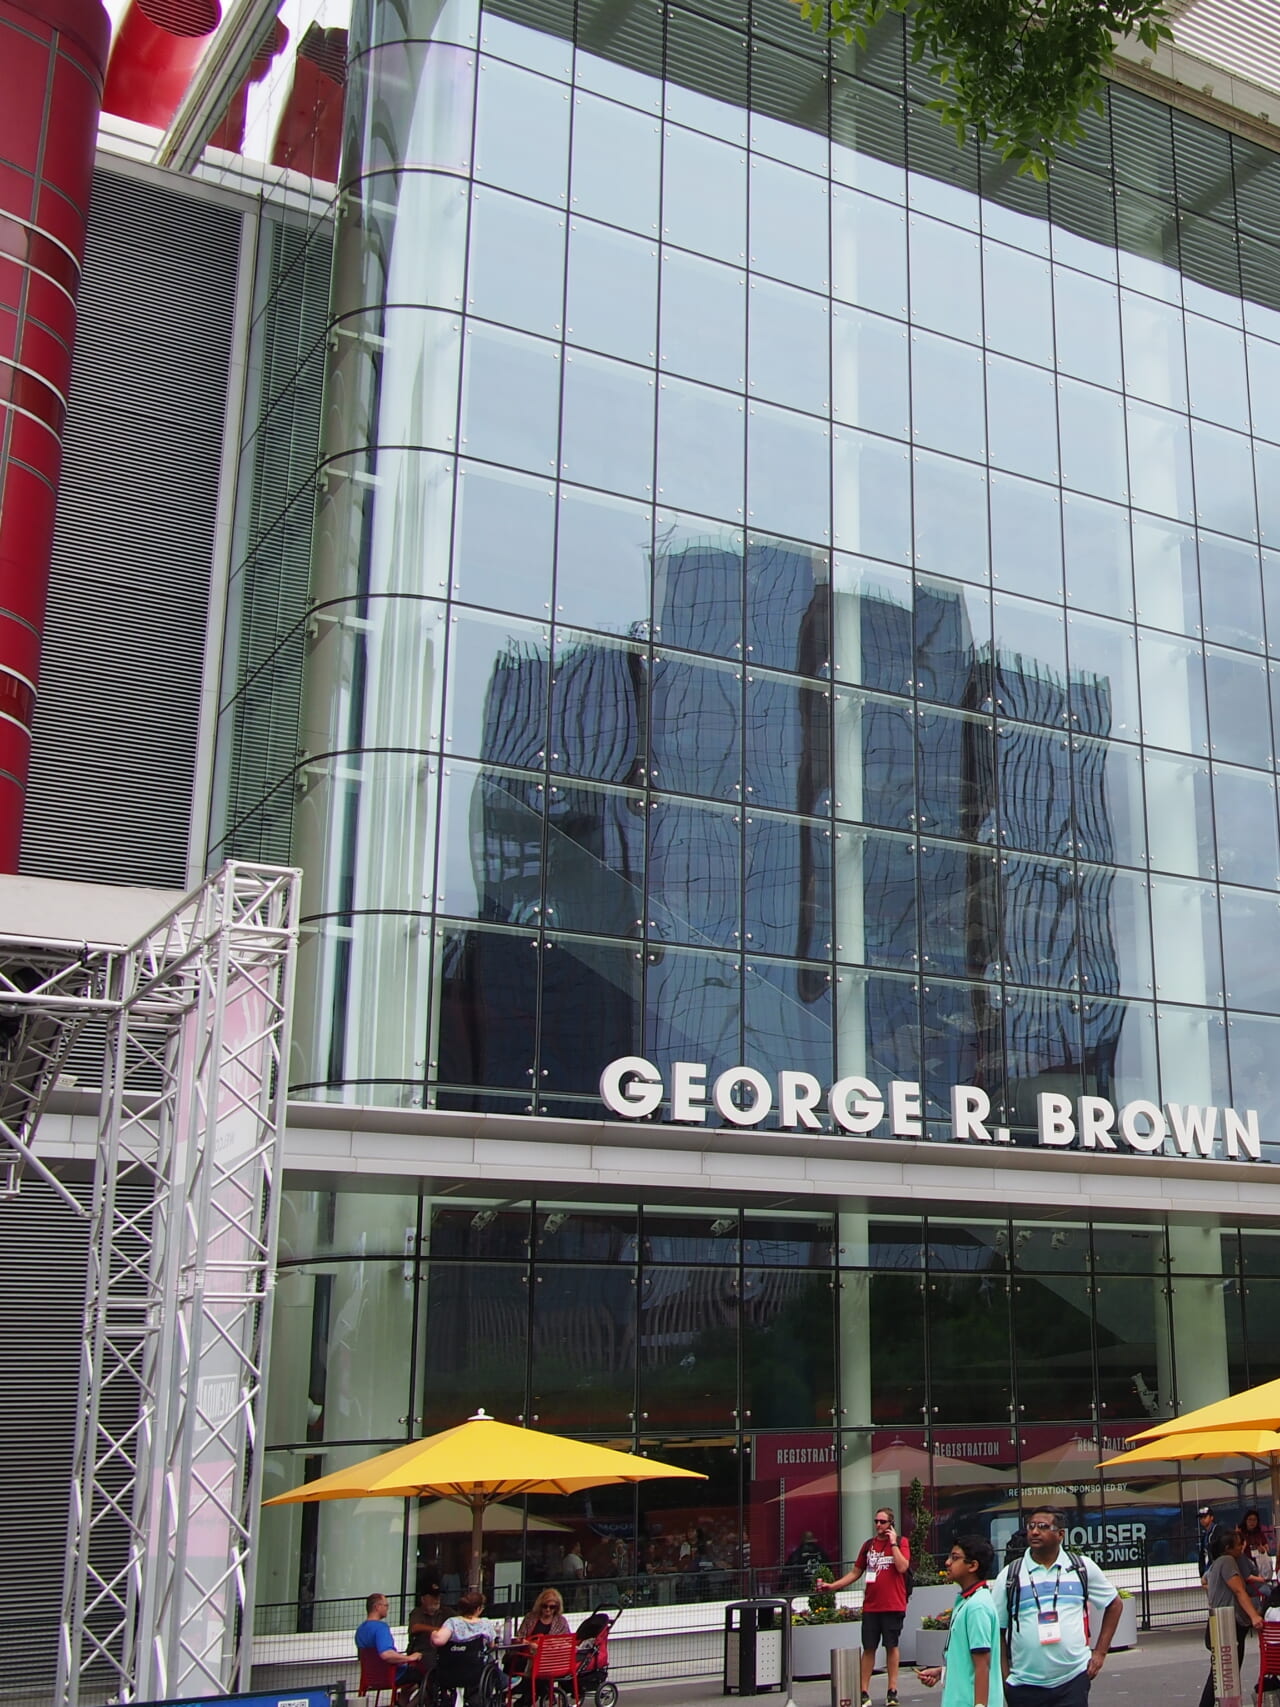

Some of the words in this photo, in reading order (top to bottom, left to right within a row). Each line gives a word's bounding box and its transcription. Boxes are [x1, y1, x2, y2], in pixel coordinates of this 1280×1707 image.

[600, 1056, 922, 1135] GEORGE
[951, 1085, 1011, 1142] R.
[1036, 1092, 1262, 1159] BROWN
[777, 1447, 838, 1464] REGISTRATI
[1117, 1483, 1128, 1493] BY
[1220, 1645, 1234, 1691] BOLIVIA
